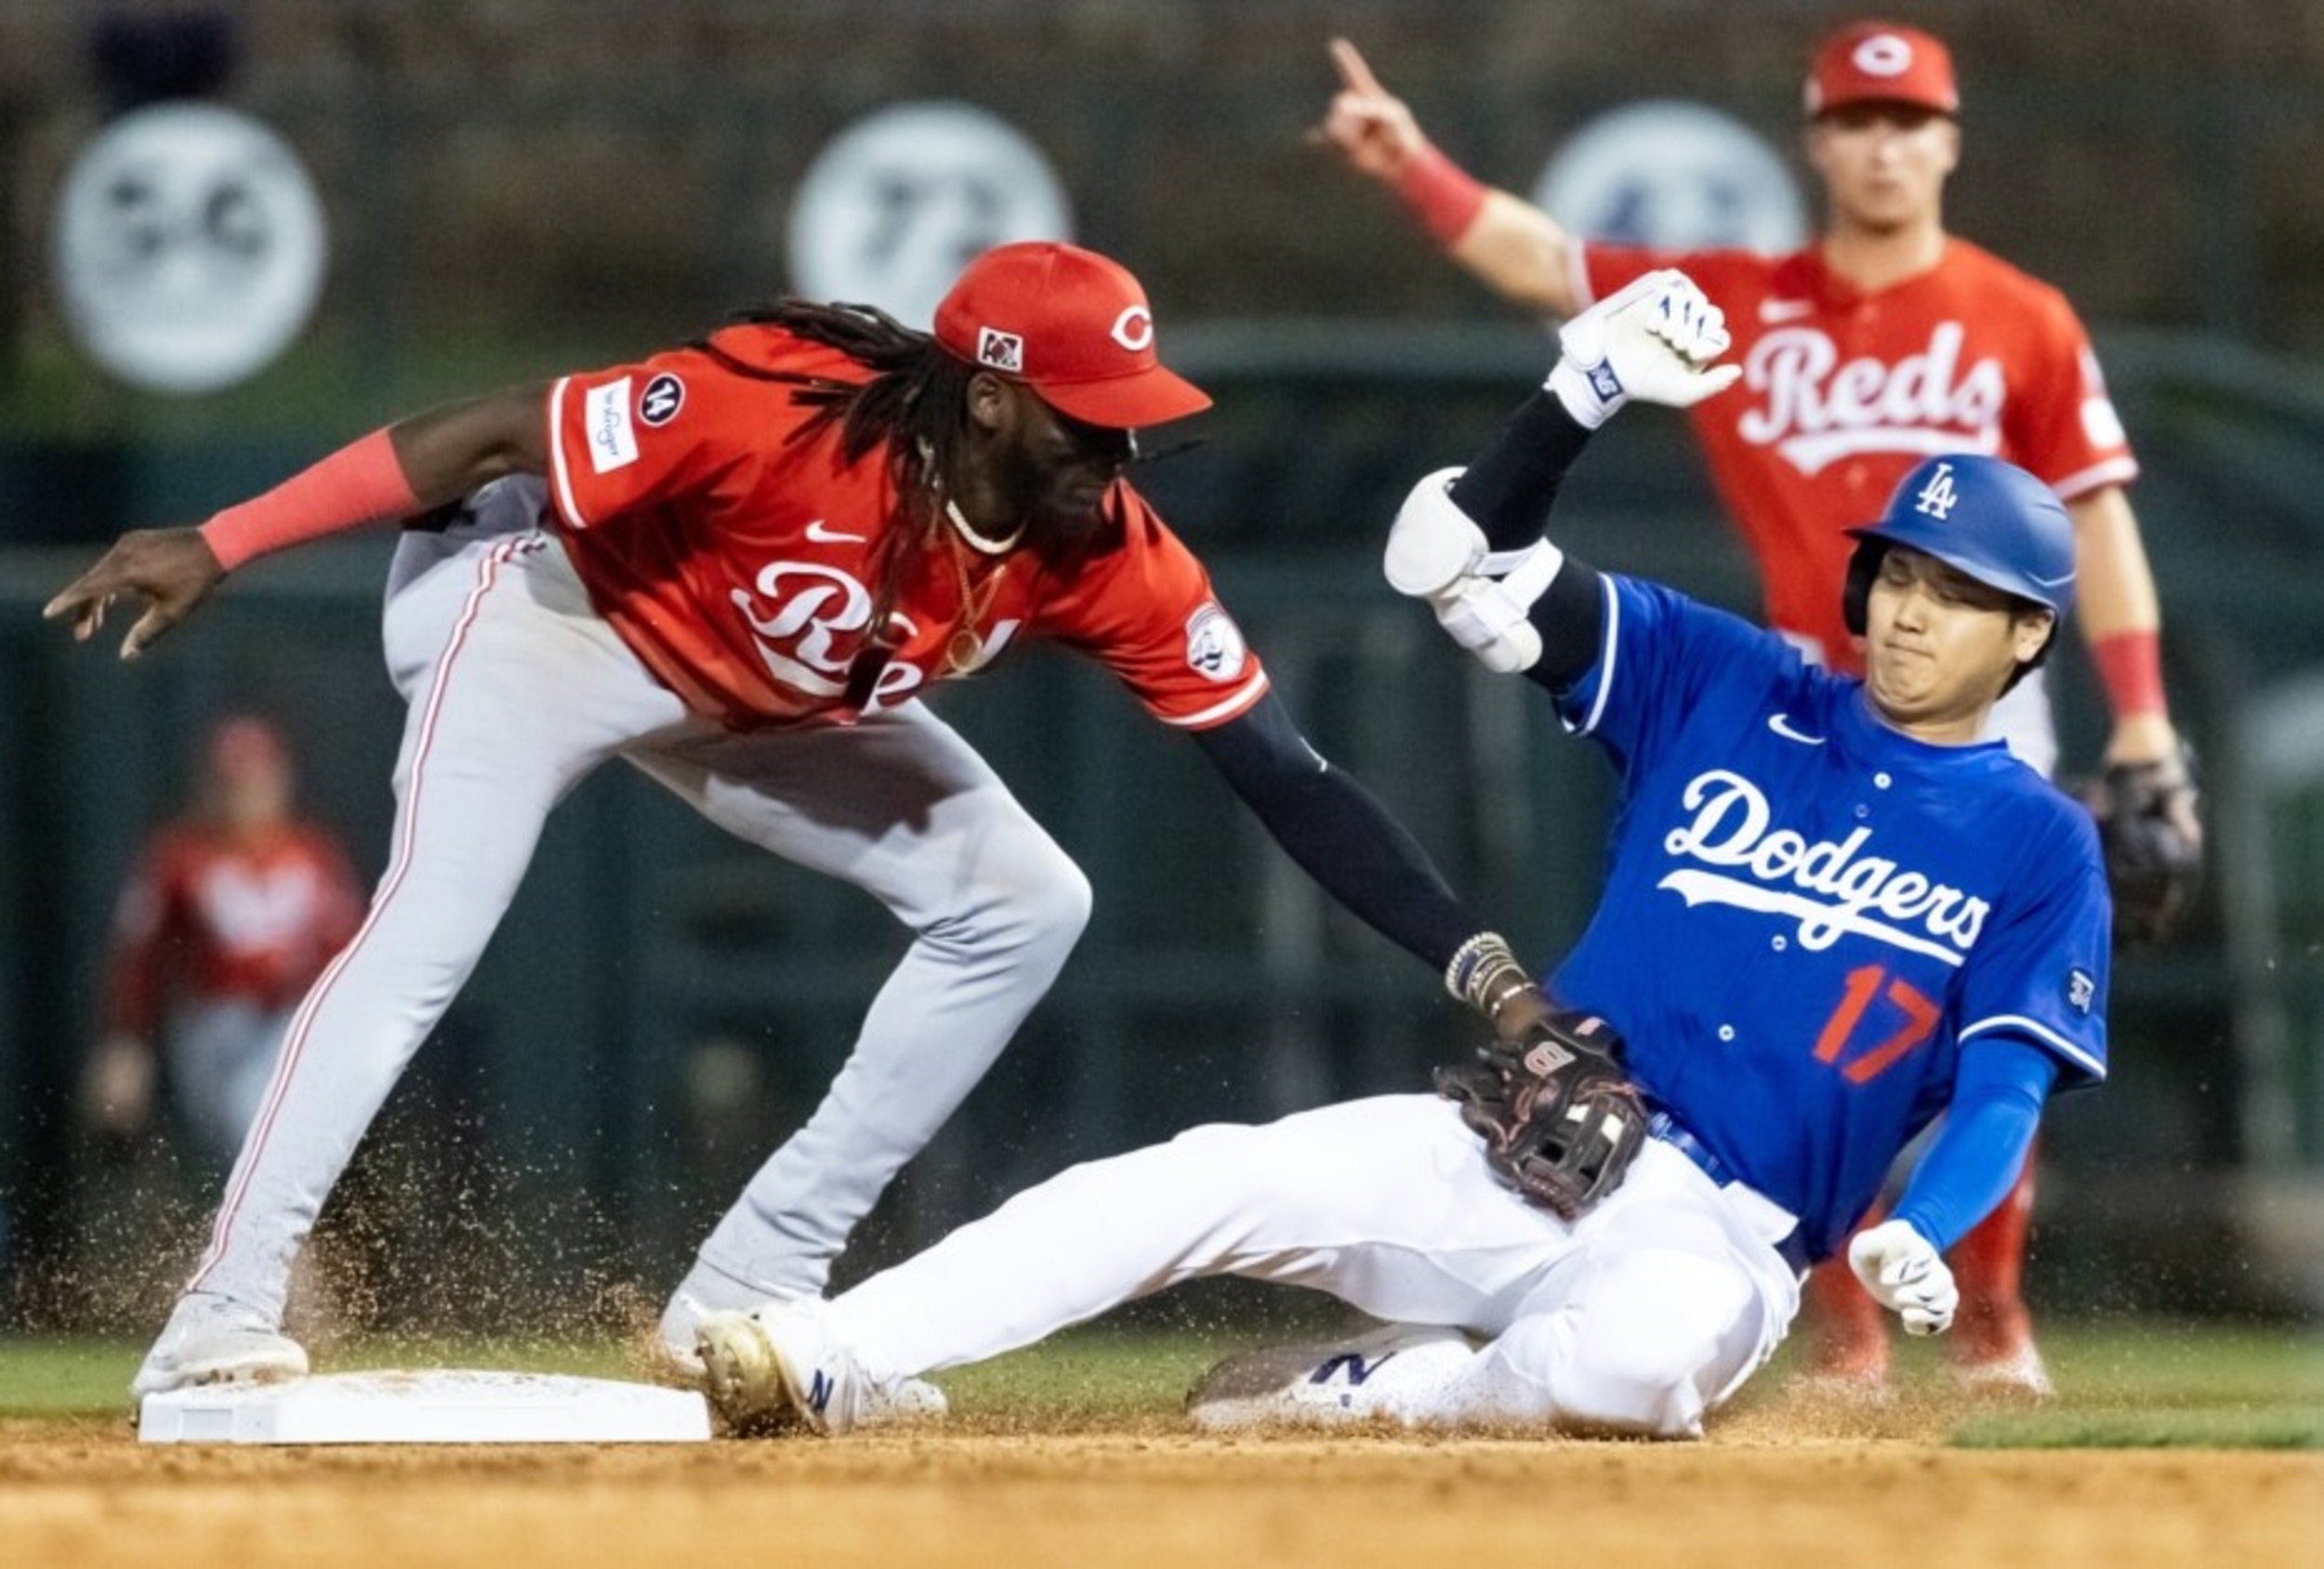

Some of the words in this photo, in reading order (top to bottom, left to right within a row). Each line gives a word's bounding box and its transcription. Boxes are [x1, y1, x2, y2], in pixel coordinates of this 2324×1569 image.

[1110, 306, 1153, 350] C
[646, 382, 676, 416] 14
[1736, 321, 2006, 457] Reds
[1915, 463, 1957, 520] LA
[1664, 770, 1990, 952] Dodgers
[1813, 965, 1941, 1087] 17
